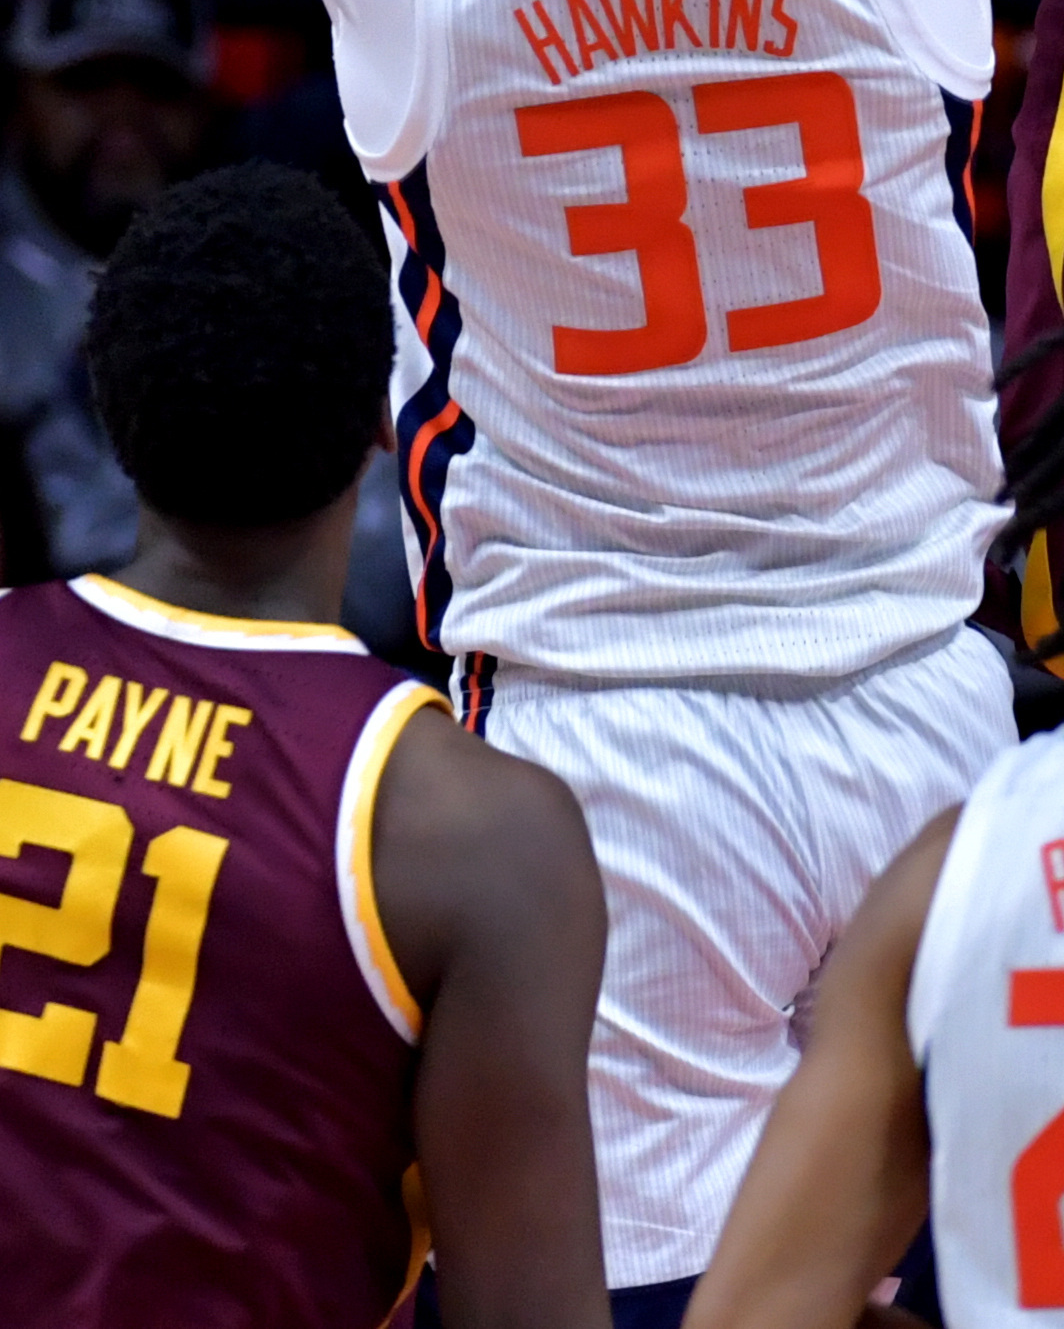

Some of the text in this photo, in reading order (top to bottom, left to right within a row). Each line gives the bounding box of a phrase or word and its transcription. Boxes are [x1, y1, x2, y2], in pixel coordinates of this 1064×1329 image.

[514, 71, 882, 376] 33
[20, 660, 253, 799] PAYNE
[0, 779, 229, 1120] 21
